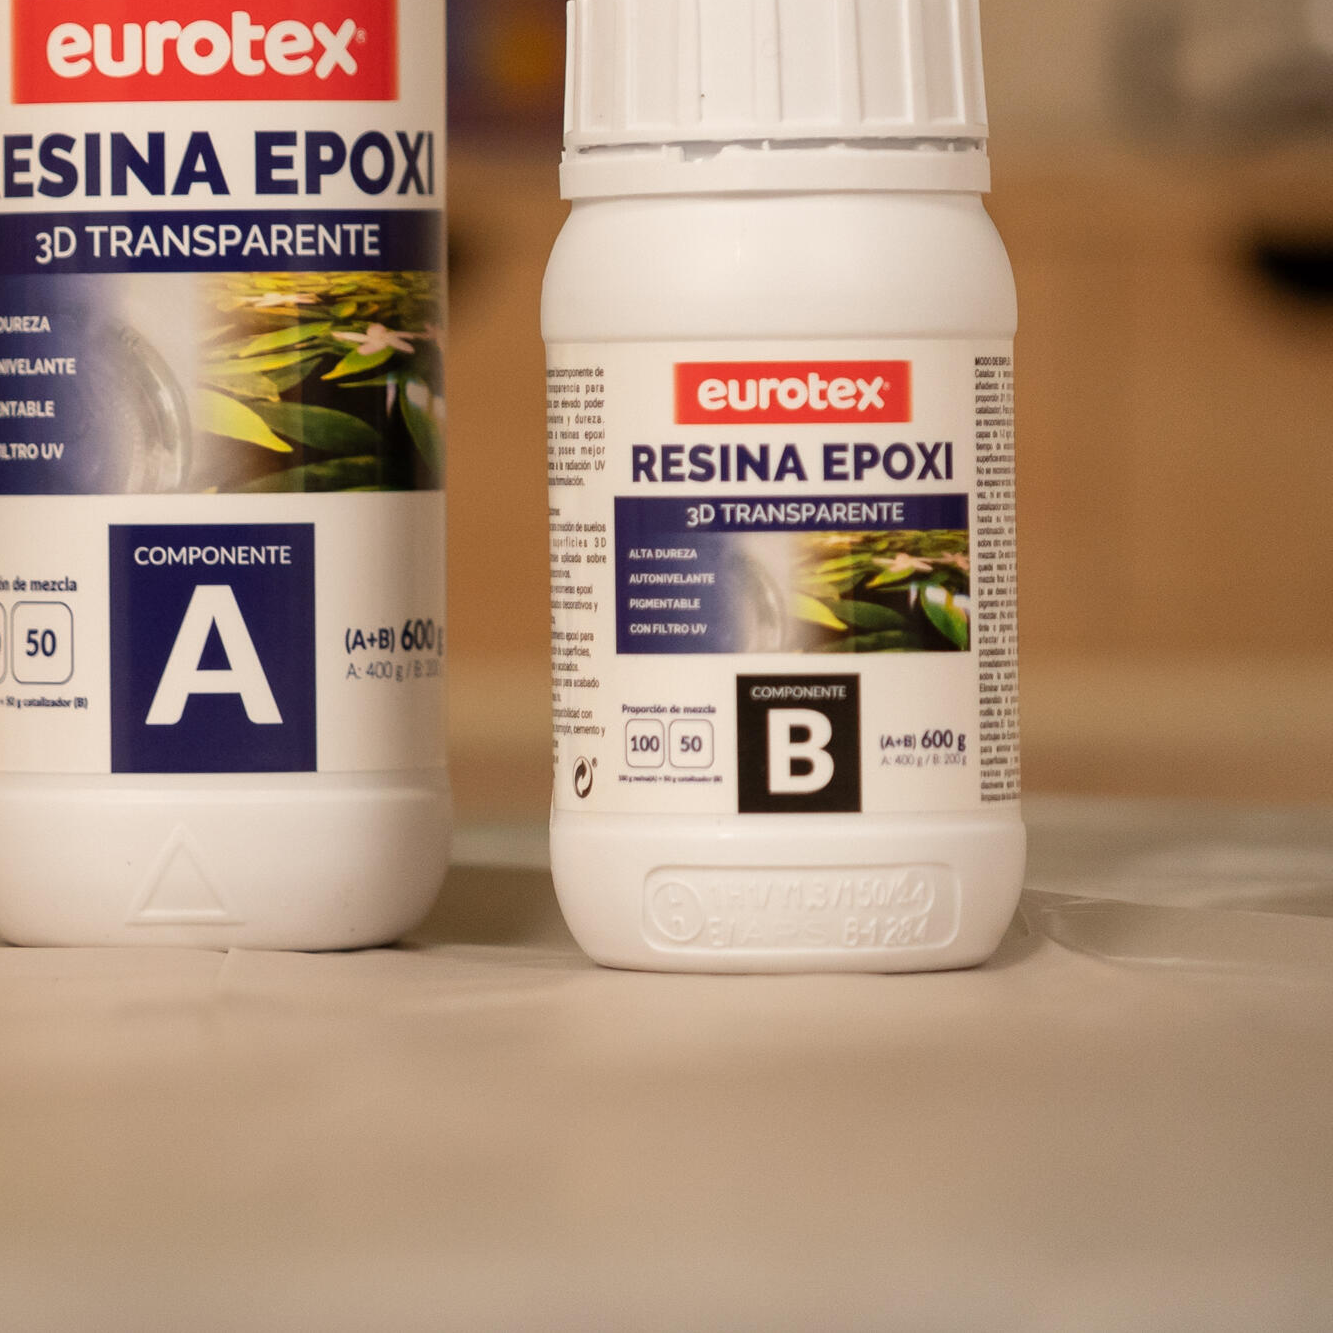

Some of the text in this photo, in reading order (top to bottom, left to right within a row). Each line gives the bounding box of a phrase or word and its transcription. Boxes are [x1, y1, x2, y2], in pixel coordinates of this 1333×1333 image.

[254, 130, 435, 196] EPOXI
[35, 224, 381, 265] 3D TRANSPARENTE
[595, 366, 604, 377] de
[585, 384, 605, 395] para
[584, 397, 605, 411] poder
[575, 413, 605, 424] dureza.
[585, 428, 605, 442] epoxi
[41, 443, 64, 459] UV
[581, 445, 605, 458] mejor
[595, 460, 606, 471] UV
[632, 441, 954, 483] RESINA EPOXI
[686, 502, 905, 528] 3D TRANSPARENTE
[575, 522, 582, 532] de
[584, 522, 606, 532] suelos
[595, 537, 606, 548] 3D
[134, 546, 291, 565] COMPONENTE
[586, 553, 606, 564] sobre
[629, 548, 698, 560] ALTA DUREZA
[12, 576, 27, 591] de
[30, 576, 78, 592] mezcla
[629, 573, 715, 585] AUTONIVELANTE
[576, 584, 593, 595] epoxi
[594, 601, 598, 613] y
[629, 598, 701, 609] PIGMENTABLE
[630, 623, 707, 635] CON FILTRO UV
[25, 628, 57, 657] 50
[345, 626, 395, 655] (A+B)
[401, 618, 435, 651] 600
[580, 632, 594, 642] para
[145, 584, 284, 726] A
[366, 661, 393, 679] 400
[573, 677, 600, 688] acabado
[751, 685, 847, 699] COMPONENTE
[581, 709, 593, 719] con
[622, 704, 716, 716] Proporción de mezcla
[573, 725, 600, 734] cemento
[601, 726, 606, 738] y
[630, 735, 702, 753] 100 50
[880, 729, 966, 752] (A+B) 600 g
[767, 708, 834, 794] B
[895, 754, 915, 765] 400
[917, 756, 922, 767] g
[944, 753, 961, 765] 200
